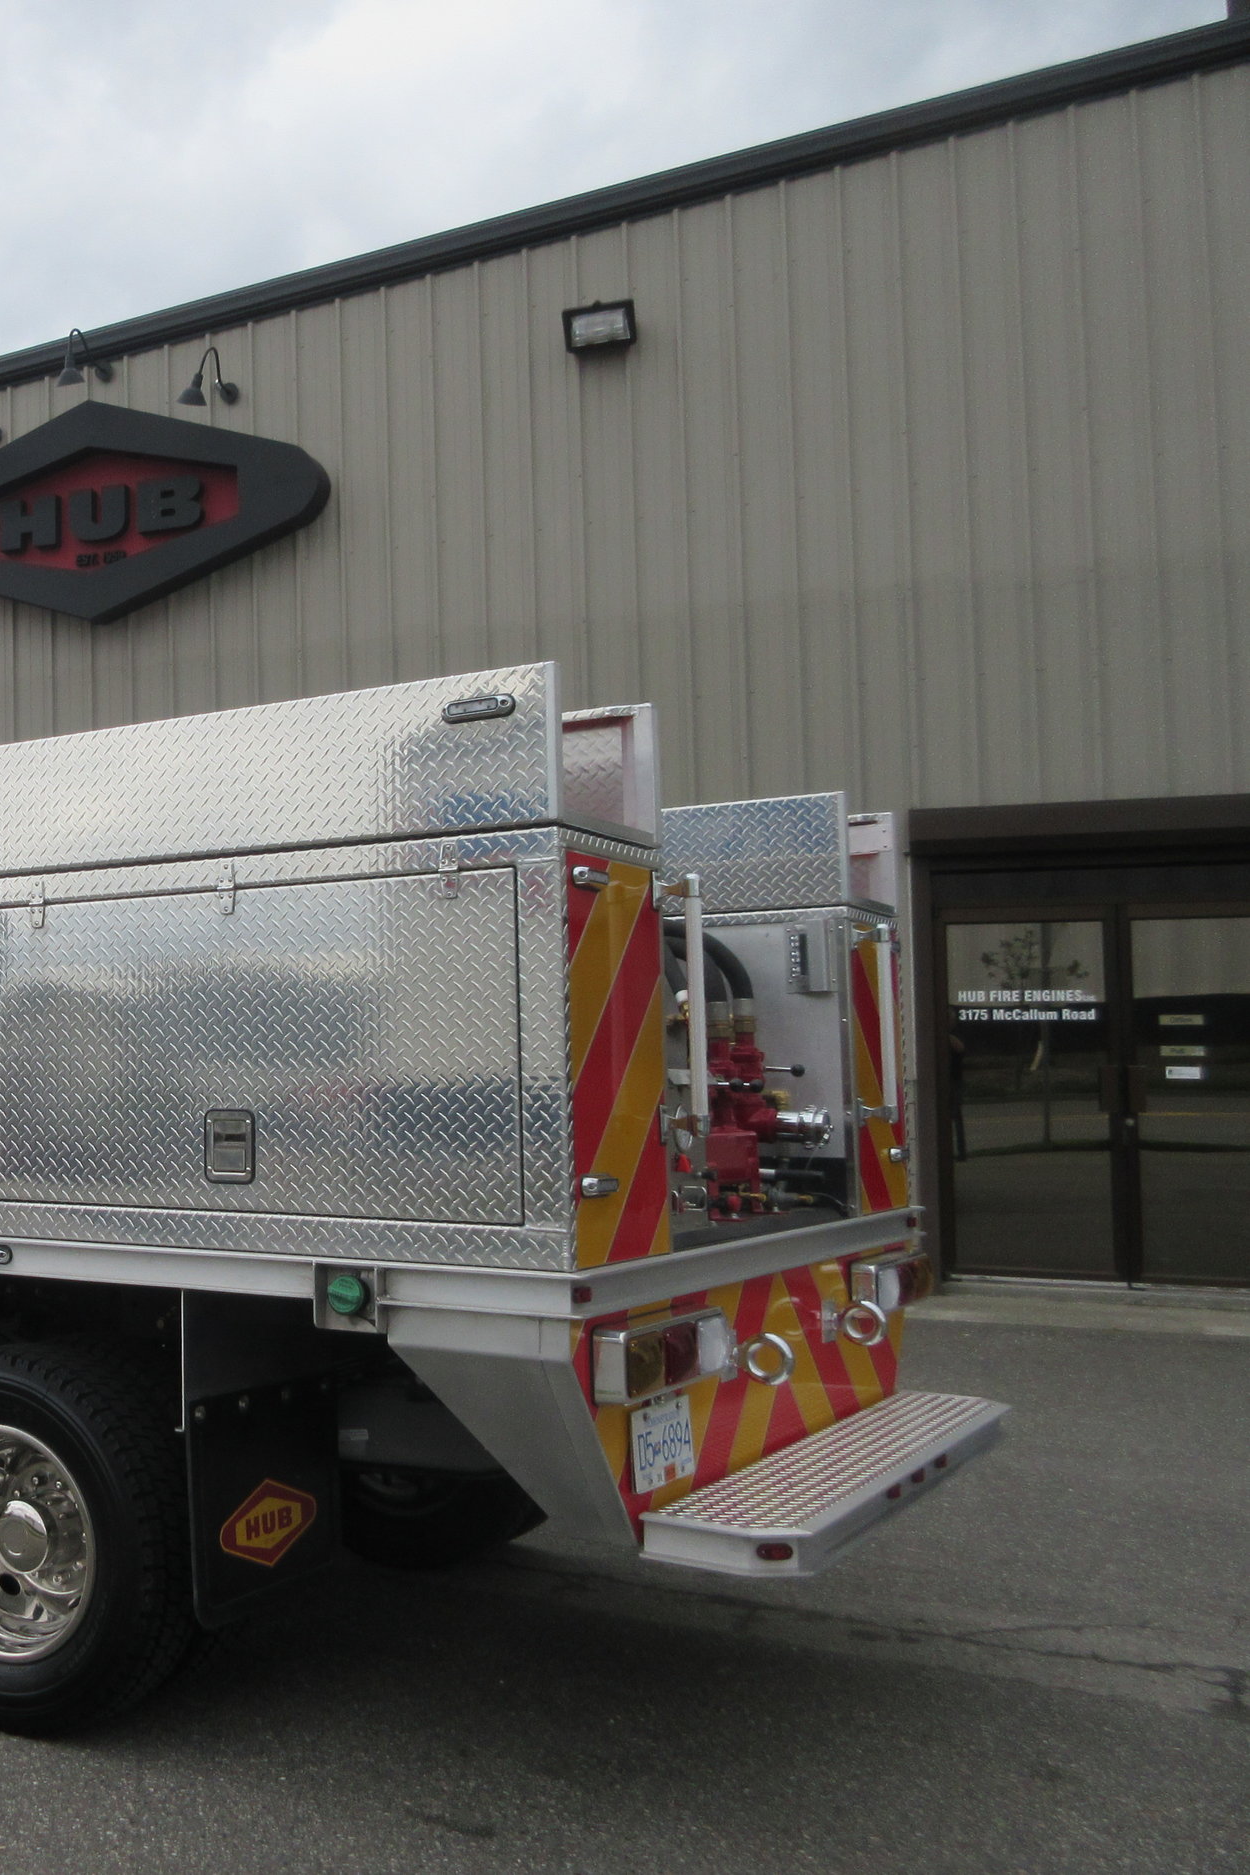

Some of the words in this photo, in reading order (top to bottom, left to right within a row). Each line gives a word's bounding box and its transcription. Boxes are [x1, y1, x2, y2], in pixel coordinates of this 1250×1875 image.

[958, 990, 986, 1002] HUB
[989, 990, 1021, 1002] FIRE
[1024, 989, 1082, 1002] ENGINES
[958, 1009, 988, 1021] 3175
[992, 1008, 1058, 1021] McCallum
[1062, 1008, 1096, 1021] Road
[662, 1419, 691, 1461] 6894
[245, 1506, 292, 1541] HUB
